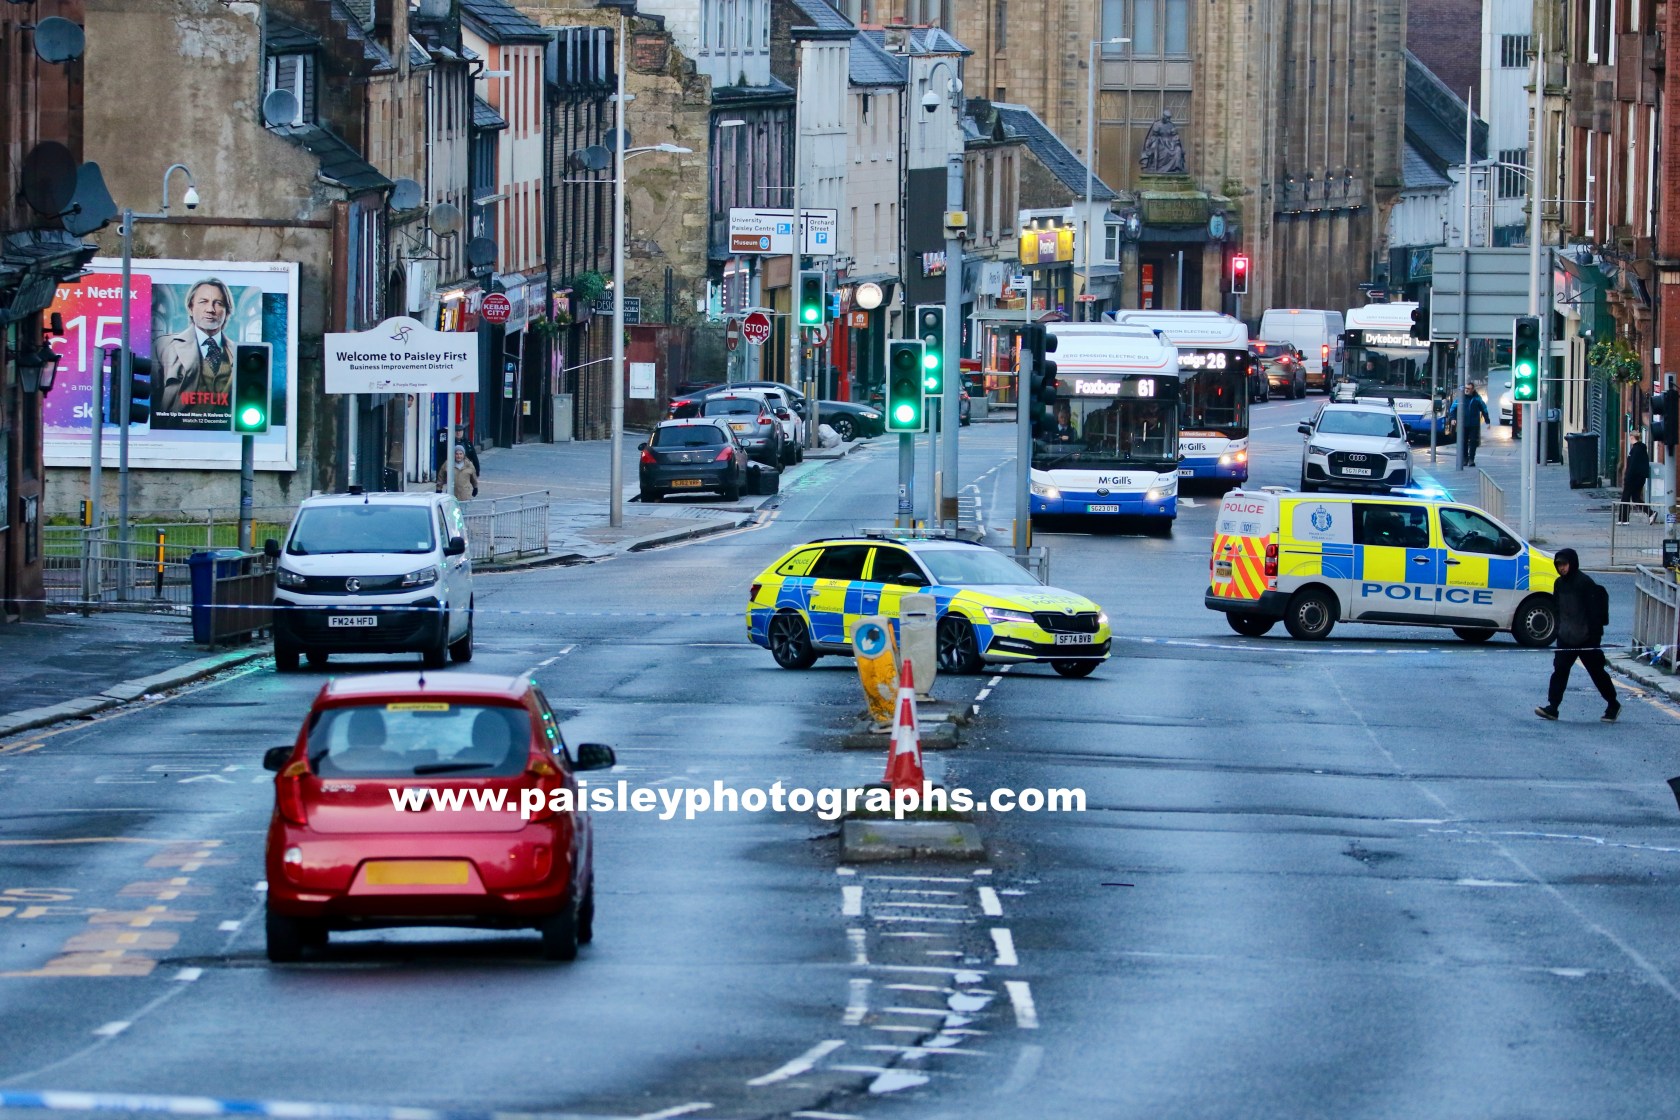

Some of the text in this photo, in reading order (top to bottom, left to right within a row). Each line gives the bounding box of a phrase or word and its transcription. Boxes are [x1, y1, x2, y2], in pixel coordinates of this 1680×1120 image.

[55, 287, 69, 300] ky
[87, 286, 138, 300] Netflx
[745, 324, 769, 334] STOP
[1365, 333, 1402, 345] Dykebar
[336, 351, 467, 362] Welcome to Paisley First
[1206, 352, 1227, 369] 26
[381, 363, 427, 371] Improvement
[1075, 379, 1155, 397] Foxbar 61
[181, 391, 229, 406] NETFLIX
[1098, 476, 1132, 485] McGill's
[1223, 502, 1265, 514] POLICE
[1243, 522, 1252, 530] 101
[1361, 583, 1494, 605] POLICE
[332, 617, 374, 626] FM24 HFD
[1059, 634, 1092, 644] SF74 BVB
